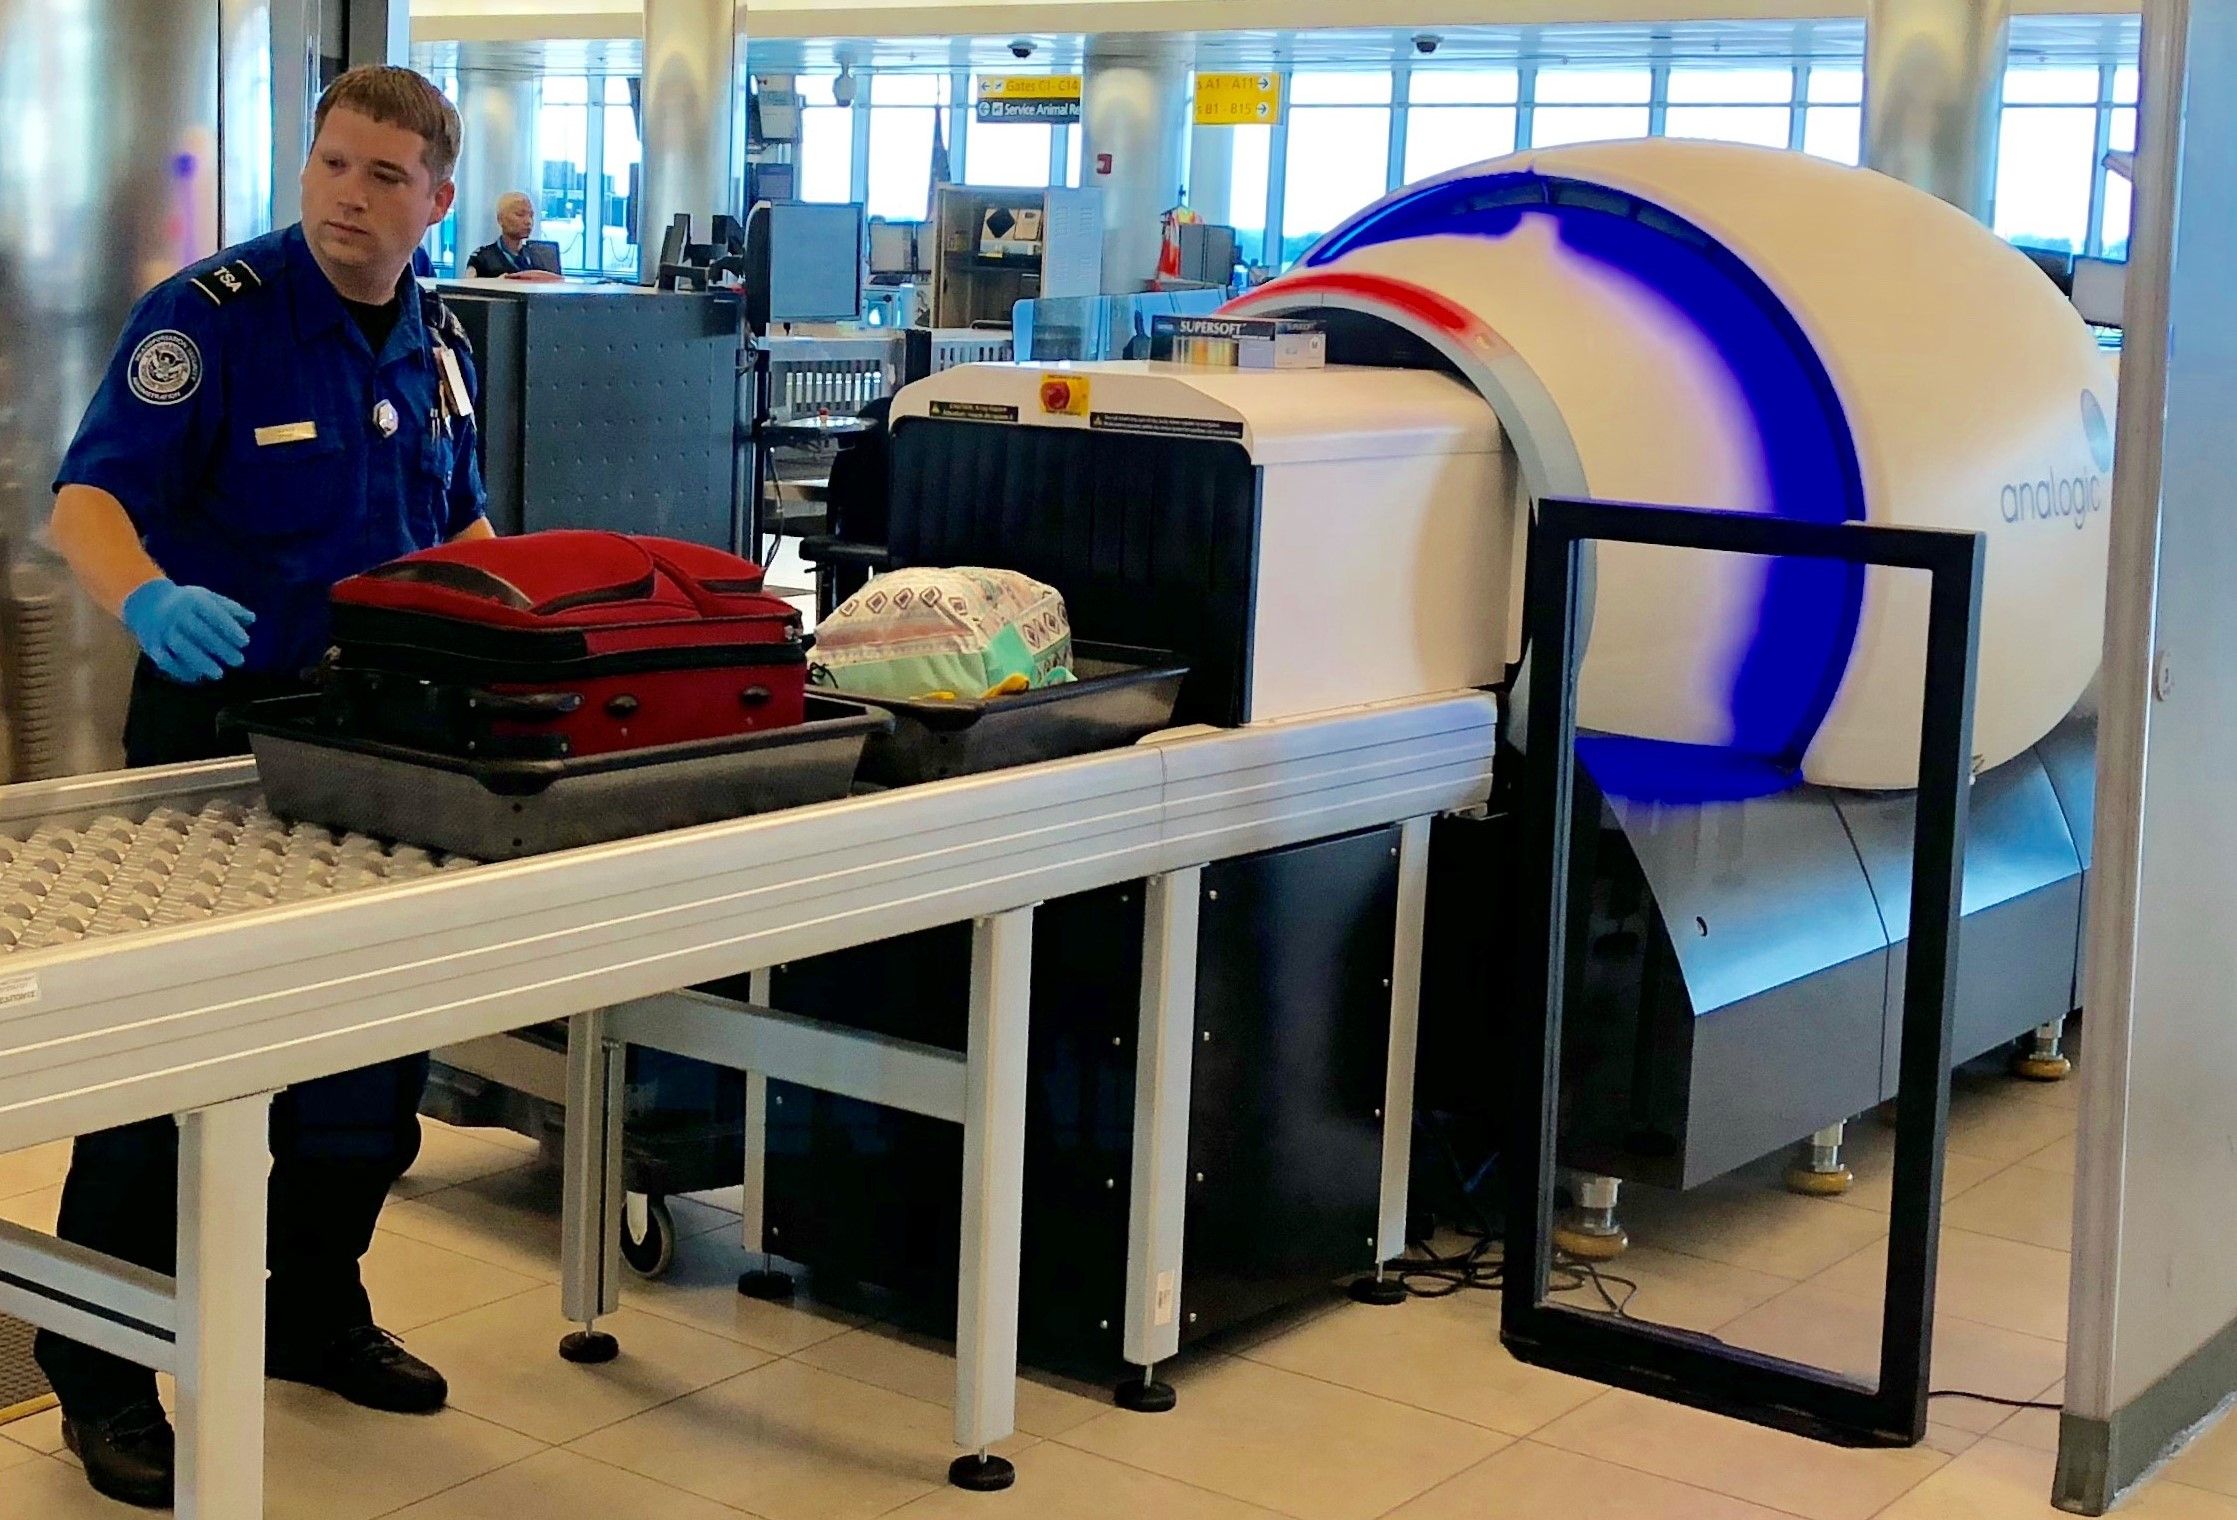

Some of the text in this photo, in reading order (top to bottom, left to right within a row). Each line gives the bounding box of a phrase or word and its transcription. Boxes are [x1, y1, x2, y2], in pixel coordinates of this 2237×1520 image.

[1006, 79, 1036, 92] Gates
[1004, 103, 1036, 116] Service
[1036, 102, 1069, 116] Animal
[213, 266, 242, 293] TSA
[1180, 321, 1241, 335] SUPERSOFT
[2000, 465, 2102, 530] analogic
